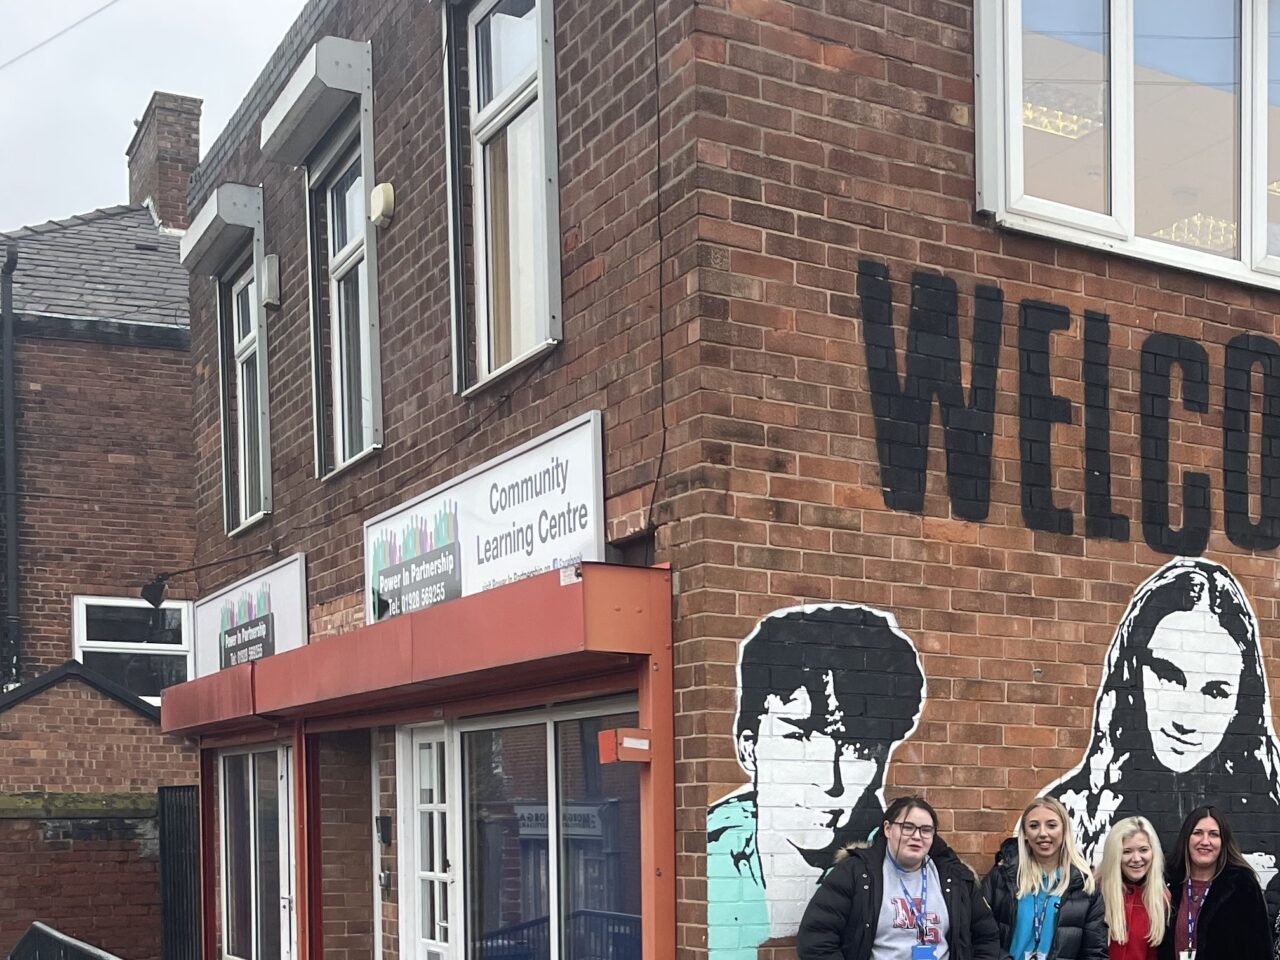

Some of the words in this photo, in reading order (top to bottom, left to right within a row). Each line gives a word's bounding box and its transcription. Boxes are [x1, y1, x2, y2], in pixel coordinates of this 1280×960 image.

[490, 456, 568, 515] Community
[477, 521, 534, 566] Learning
[538, 502, 588, 544] Centre
[380, 573, 401, 594] Power
[403, 567, 409, 586] In
[411, 551, 454, 583] Partnership
[388, 597, 400, 616] Tel:
[401, 590, 419, 612] 01928
[421, 582, 445, 606] 569255
